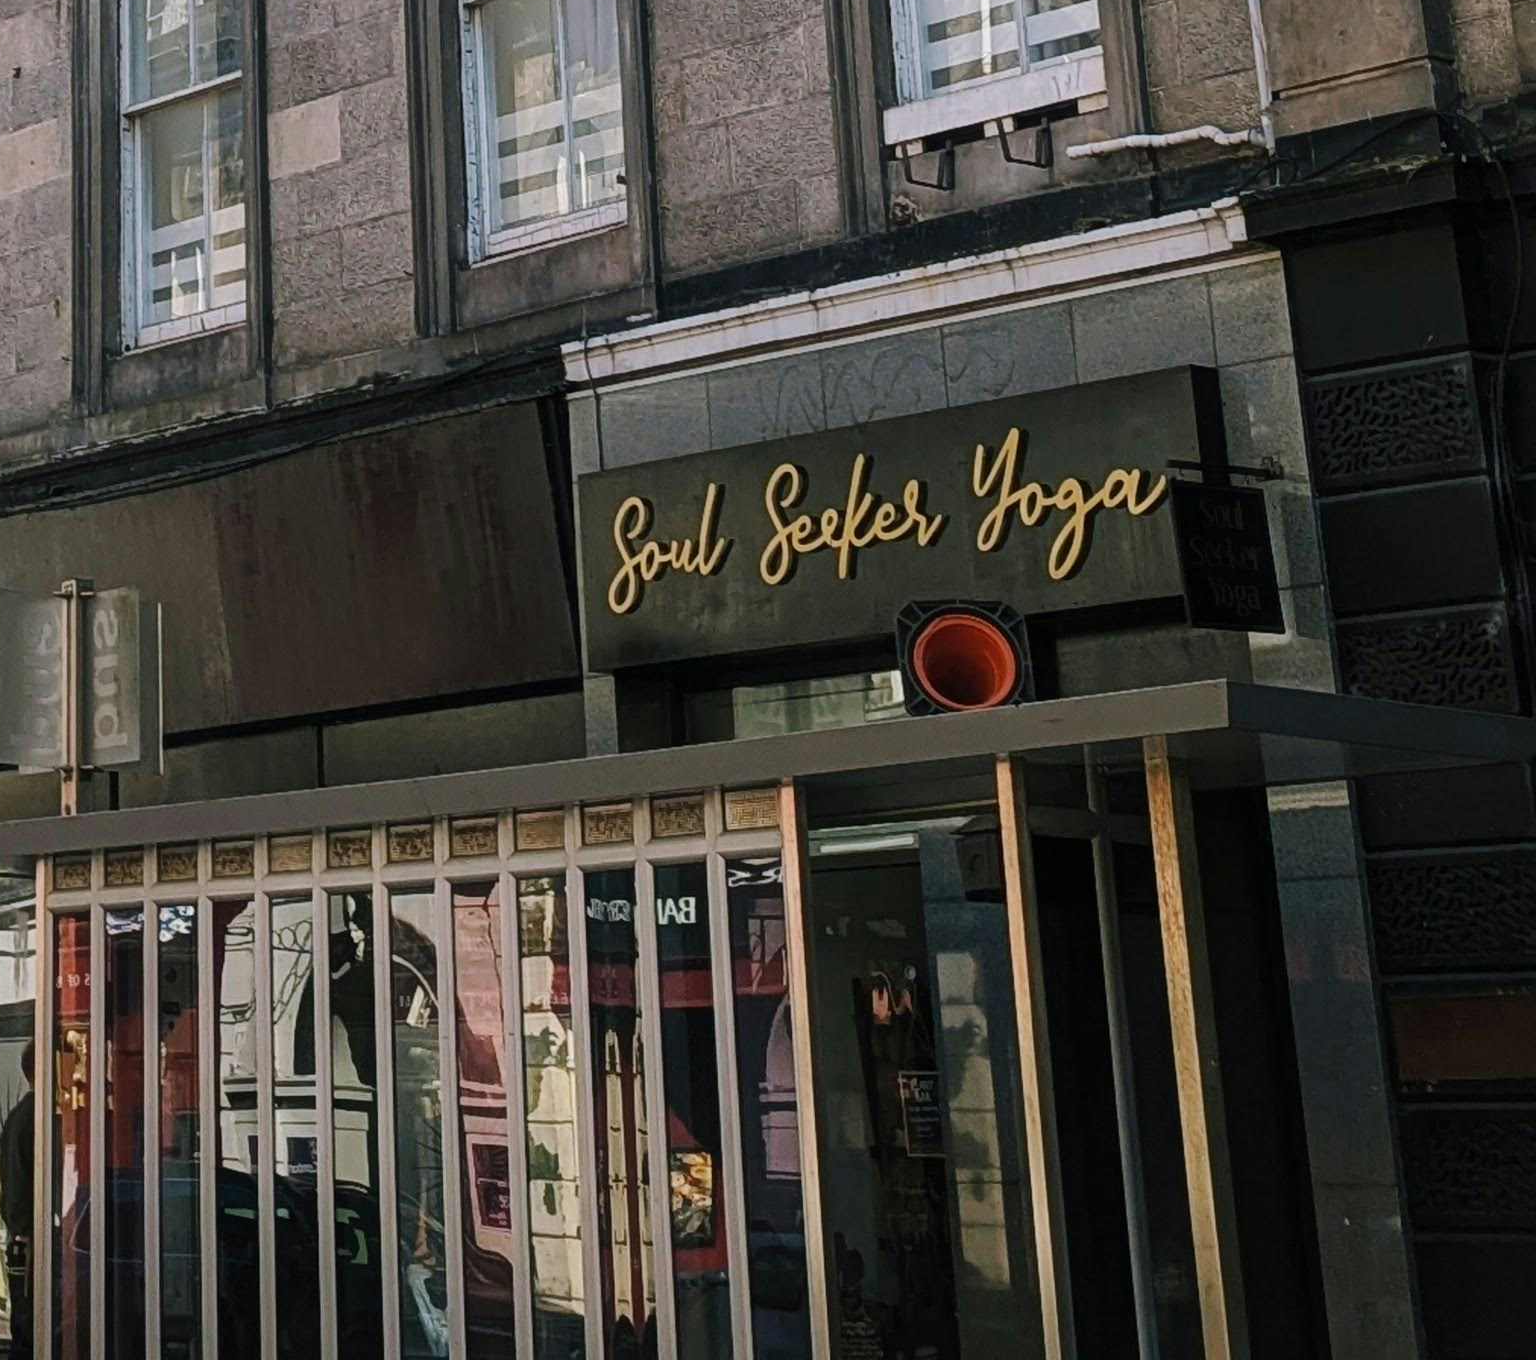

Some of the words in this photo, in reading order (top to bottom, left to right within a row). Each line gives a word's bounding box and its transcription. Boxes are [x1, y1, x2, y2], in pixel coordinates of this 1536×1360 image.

[607, 482, 727, 614] Soul
[760, 453, 943, 585] Seeker
[972, 427, 1167, 580] Yoga
